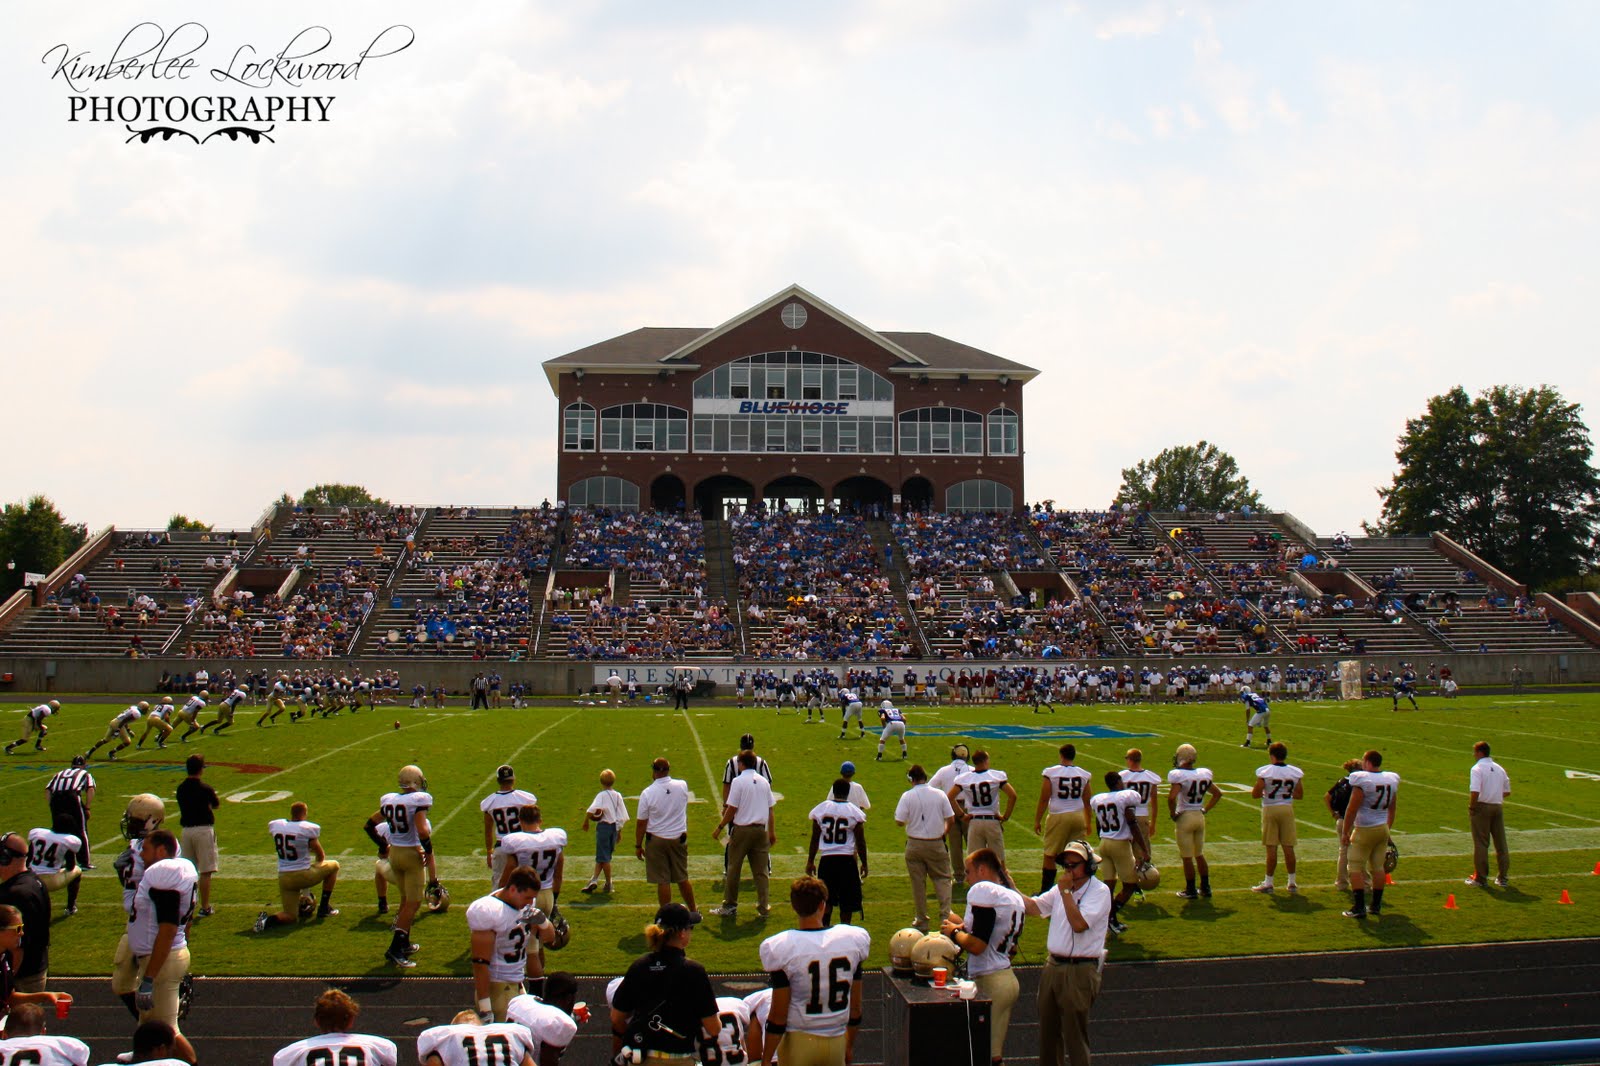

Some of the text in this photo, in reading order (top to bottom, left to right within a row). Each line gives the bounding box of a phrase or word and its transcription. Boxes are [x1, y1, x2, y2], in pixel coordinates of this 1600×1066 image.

[970, 782, 993, 807] 18
[1058, 777, 1083, 799] 58
[1268, 779, 1294, 800] 73
[1370, 784, 1392, 810] 71
[492, 806, 521, 834] 82
[822, 817, 849, 844] 36
[1097, 803, 1121, 833] 33
[32, 840, 59, 867] 34
[274, 833, 298, 861] 85
[531, 850, 557, 881] 17
[806, 957, 852, 1015] 16
